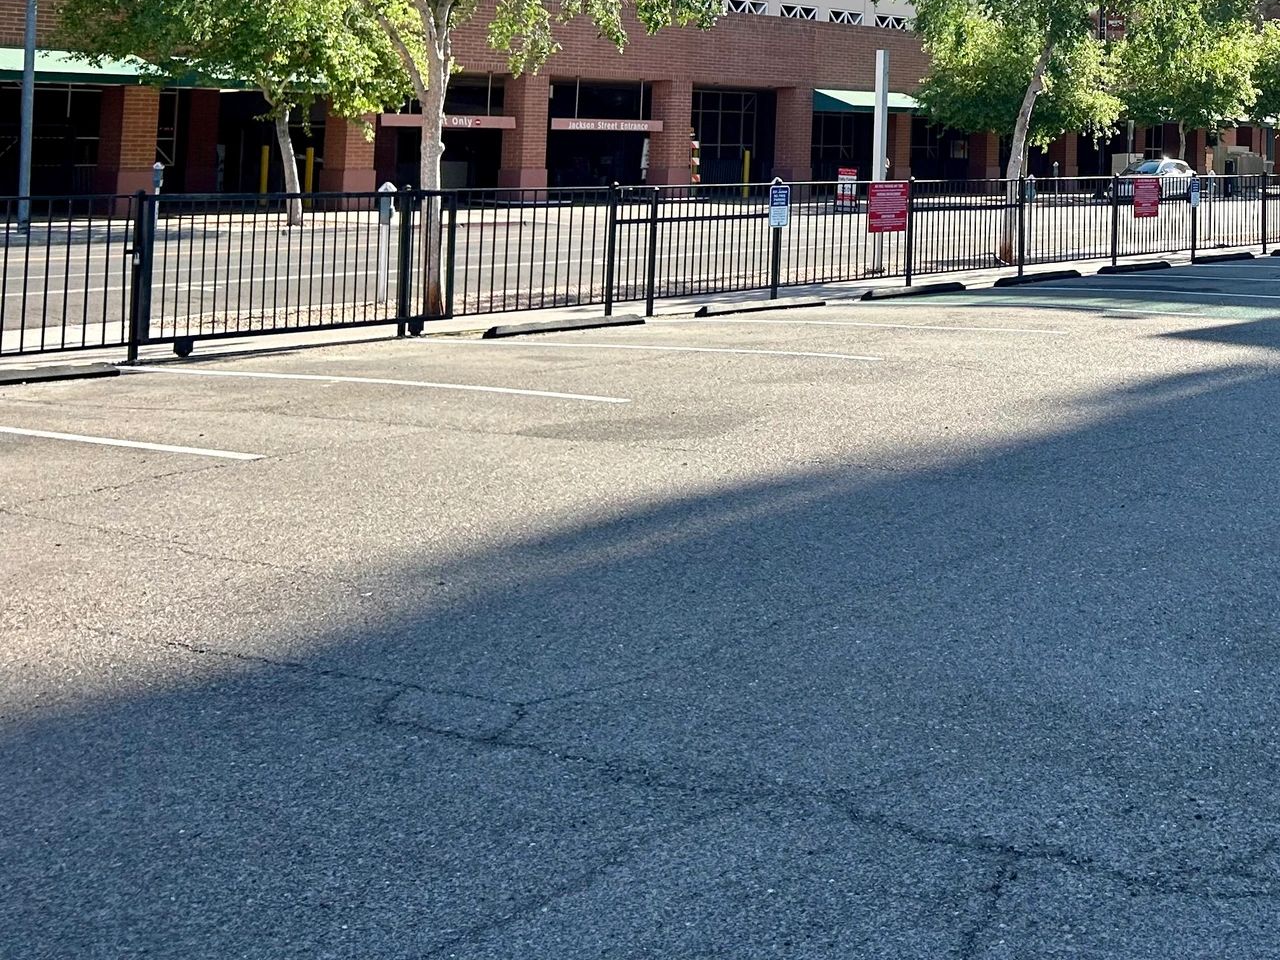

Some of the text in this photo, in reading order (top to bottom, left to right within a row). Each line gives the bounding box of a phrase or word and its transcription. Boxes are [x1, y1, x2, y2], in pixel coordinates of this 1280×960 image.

[452, 117, 472, 128] Only
[568, 121, 649, 130] Jackson Street Entrance
